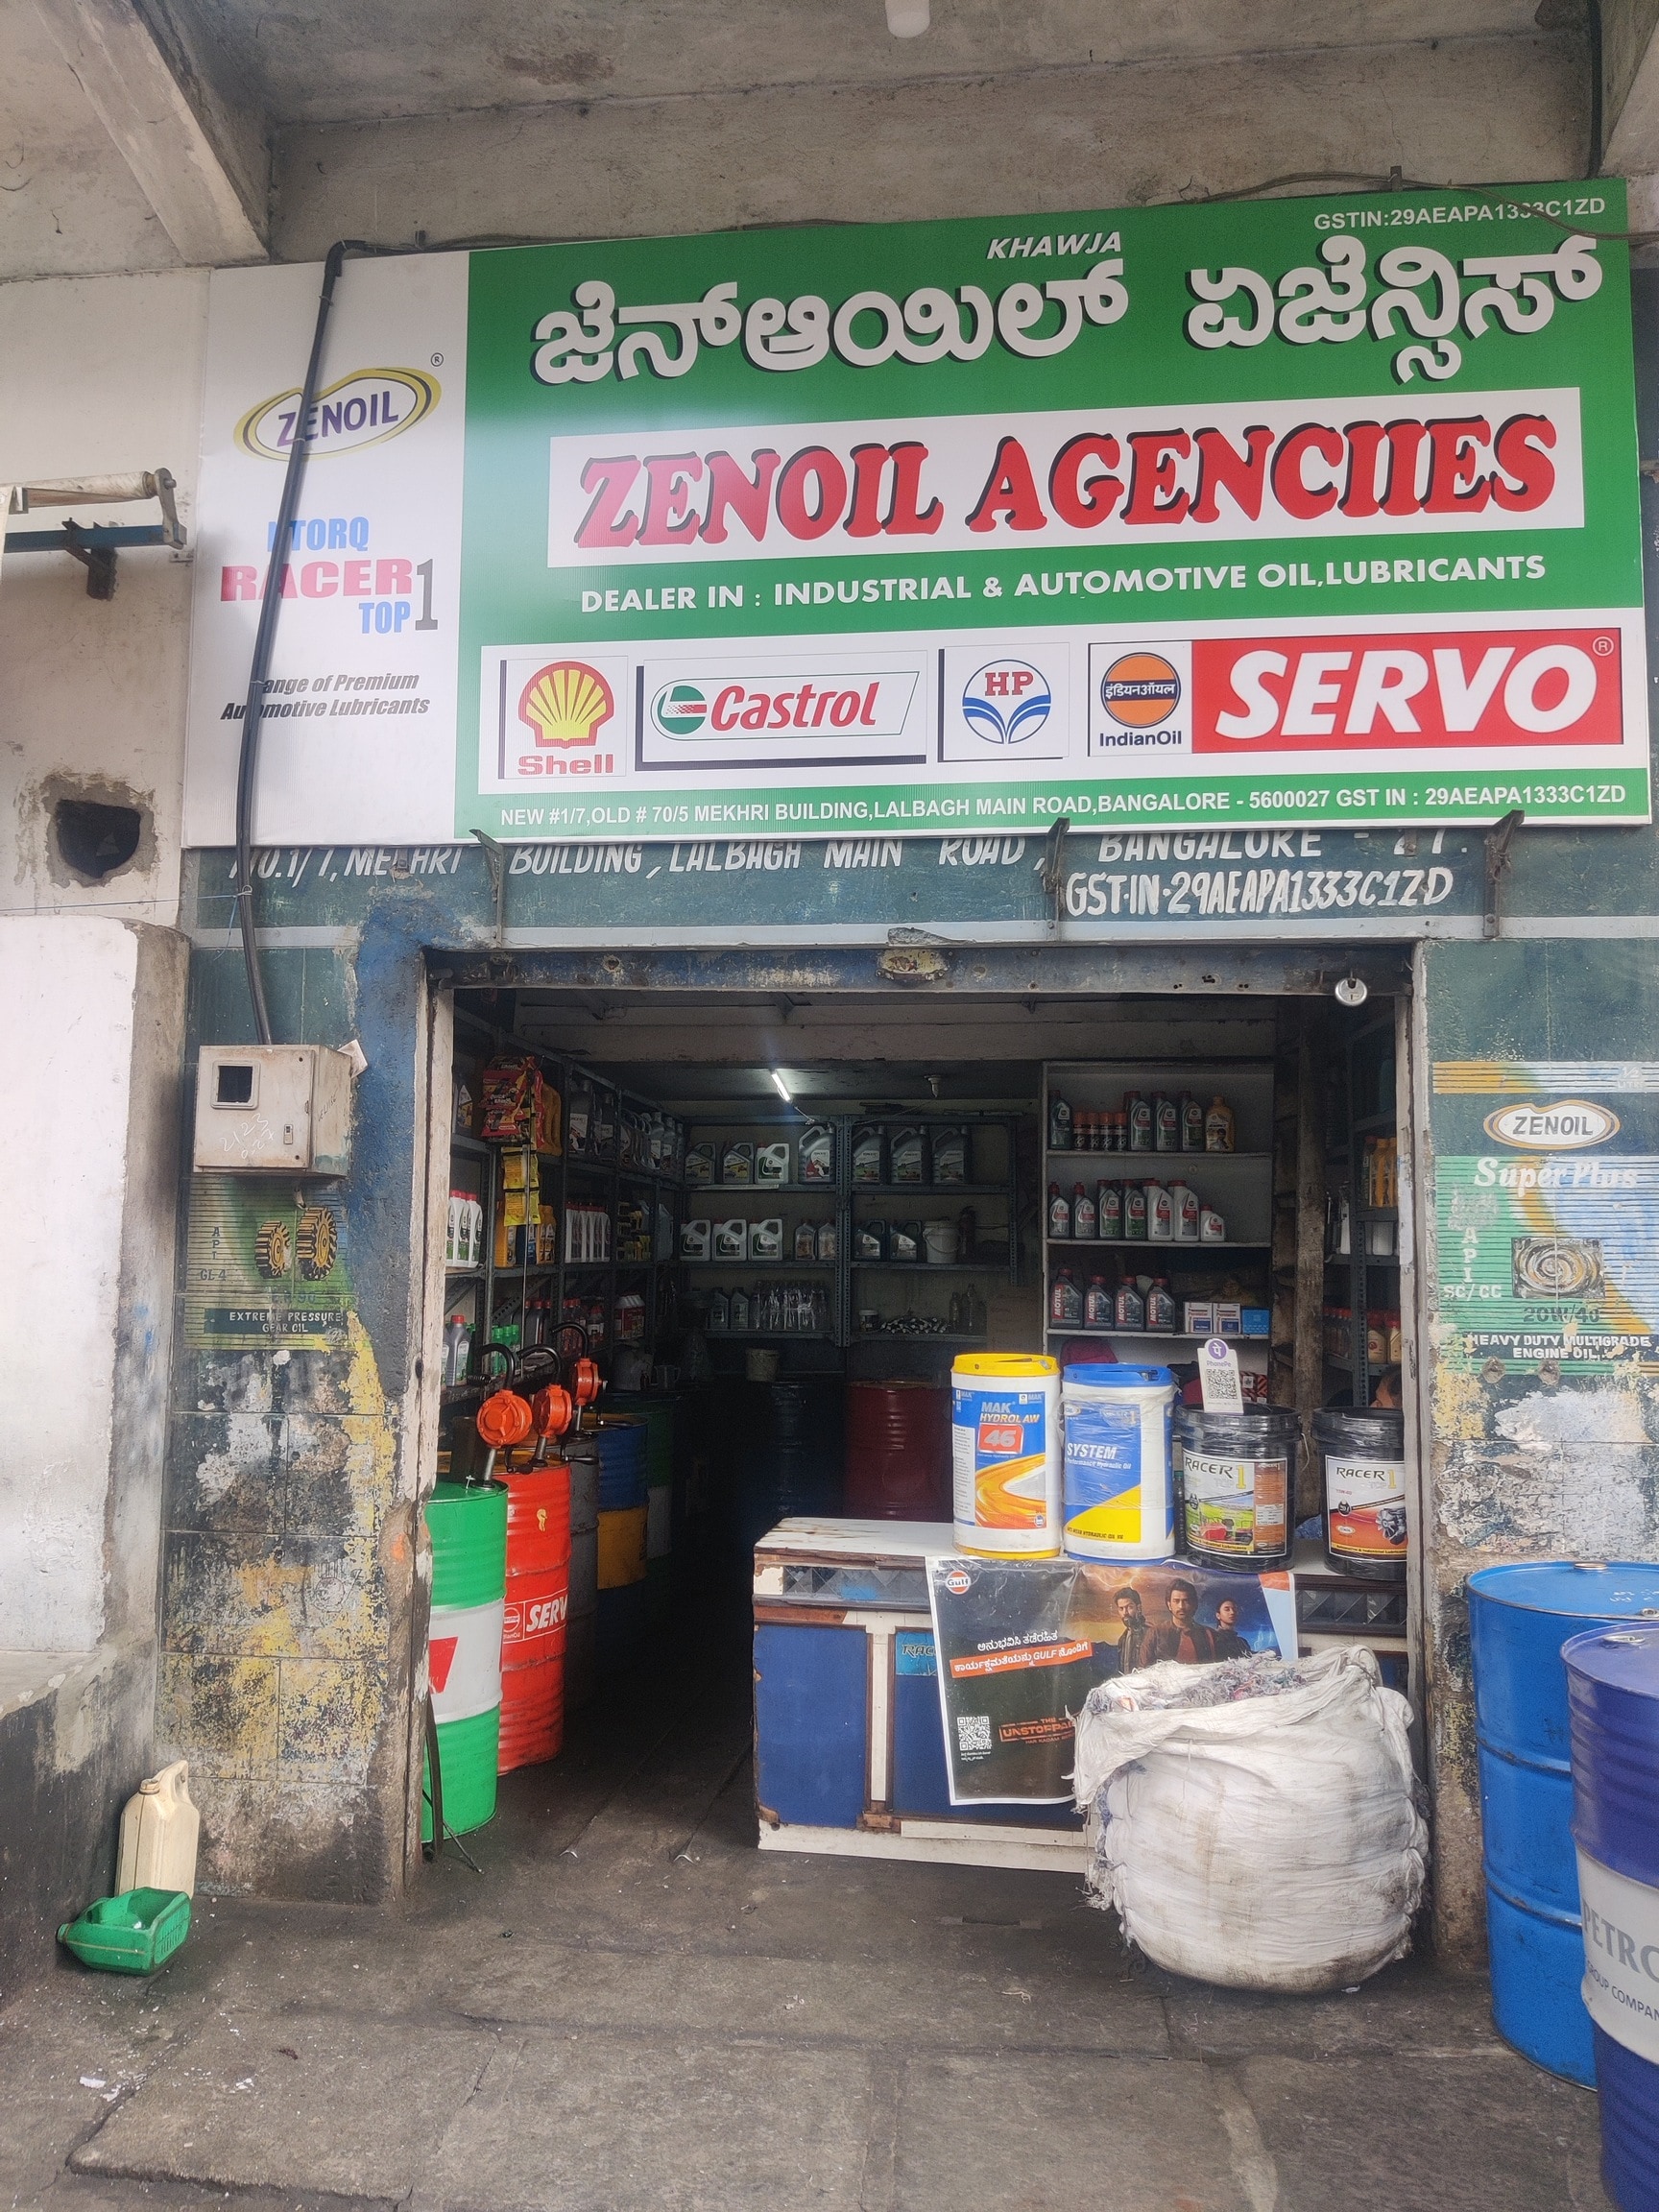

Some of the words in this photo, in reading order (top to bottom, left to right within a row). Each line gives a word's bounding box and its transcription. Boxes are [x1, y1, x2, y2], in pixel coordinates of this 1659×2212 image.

[987, 231, 1121, 259] KHAWJA
[573, 443, 944, 548] ZENOIL
[966, 413, 1557, 533] AGENCIIES
[581, 587, 696, 613] DEALER
[709, 585, 744, 608] IN
[774, 576, 971, 606] INDUSTRIAL
[982, 576, 1002, 598] &
[1014, 564, 1246, 597] AUTOMOTIVE
[359, 602, 411, 634] TOP
[262, 677, 309, 695] ange
[311, 675, 333, 692] of
[335, 673, 420, 690] Premium
[984, 670, 1033, 696] HP
[1214, 644, 1598, 738] SERVO
[220, 700, 327, 720] Aumotive
[329, 698, 430, 716] Lubricants
[711, 681, 880, 732] Castrol
[1099, 731, 1182, 746] IndianOil
[517, 754, 613, 776] Shell
[501, 808, 543, 826] NEW
[636, 807, 647, 823] #
[652, 805, 688, 823] 70/5
[694, 804, 769, 822] MEKHRI
[976, 797, 1025, 816] MAIN
[1249, 790, 1329, 808] 5600027
[1336, 788, 1380, 807] GST
[1385, 788, 1406, 805] IN
[1425, 784, 1625, 805] 29AEAPA1333C1ZD
[669, 840, 800, 873] LALBAGH
[824, 837, 902, 869] MAIN
[1098, 830, 1322, 862] BANGALORE
[1513, 1116, 1593, 1136] ZENOIL
[1474, 1157, 1568, 1197] Super
[1572, 1160, 1638, 1188] Plus
[200, 1269, 214, 1281] GL
[218, 1269, 227, 1281] 4
[229, 1311, 281, 1322] EXTREME
[288, 1311, 343, 1322] PRESSURE
[1523, 1304, 1599, 1323] 20W/40
[263, 1323, 287, 1333] GEAR
[292, 1323, 308, 1333] OIL
[1468, 1334, 1520, 1346] HEAVY
[1523, 1334, 1560, 1346] DUTY
[1563, 1334, 1649, 1347] MULTIGRADE
[1513, 1348, 1568, 1358] ENGINE
[982, 1402, 1010, 1413] MAK
[980, 1413, 1021, 1423] HYDROL
[1022, 1414, 1040, 1423] AW
[984, 1430, 1016, 1448] 46
[1068, 1443, 1118, 1459] SYSTEM
[1185, 1457, 1233, 1479] RACER
[1336, 1467, 1384, 1481] RACER
[902, 1645, 936, 1658] RAC
[1033, 1649, 1057, 1660] GULF
